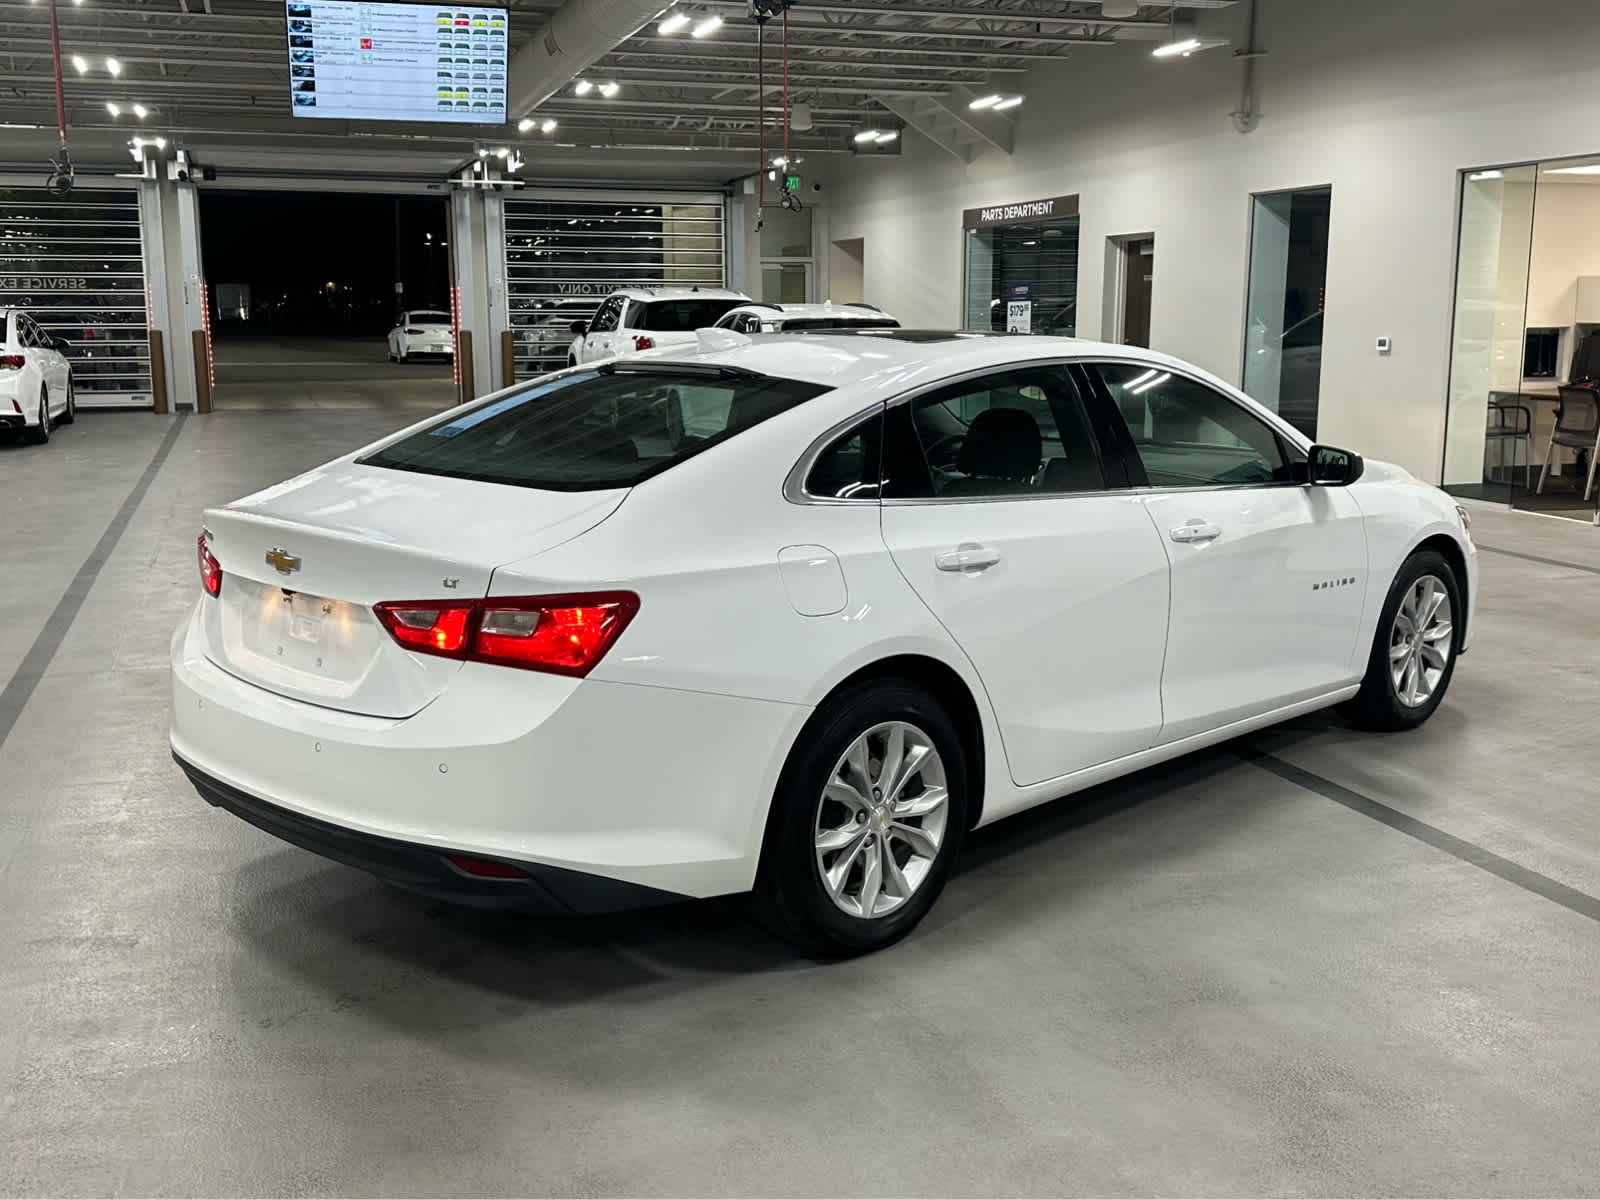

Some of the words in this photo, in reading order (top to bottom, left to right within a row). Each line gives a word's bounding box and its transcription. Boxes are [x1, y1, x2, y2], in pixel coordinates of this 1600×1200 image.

[981, 208, 1003, 222] PARTS
[1004, 200, 1054, 220] DEPARTMENT
[443, 577, 460, 589] LT
